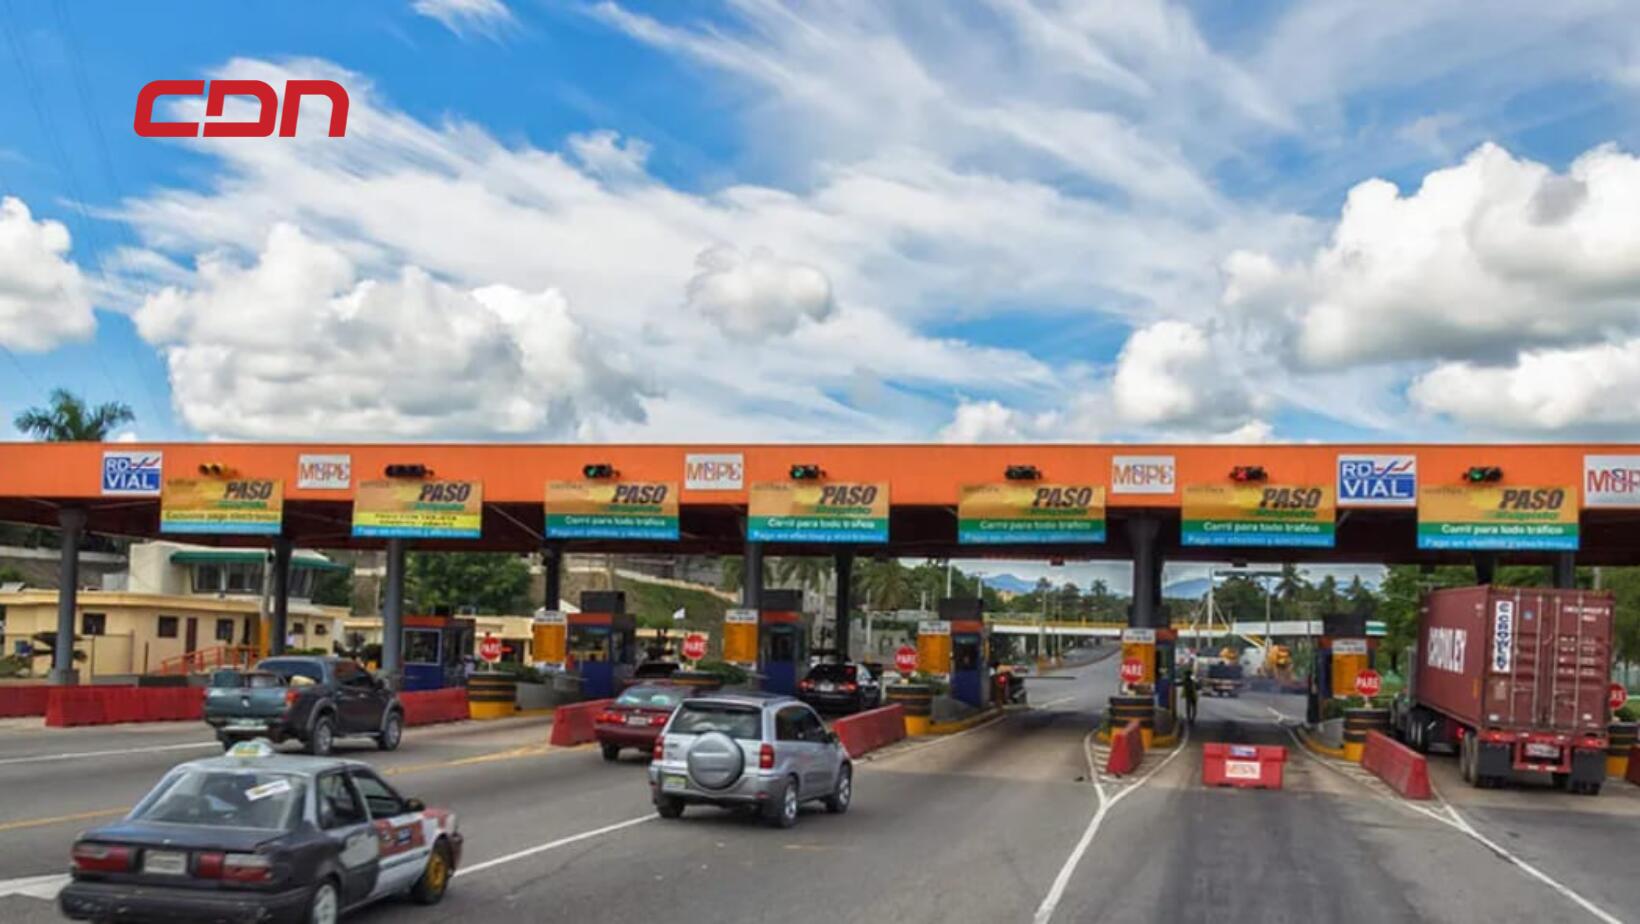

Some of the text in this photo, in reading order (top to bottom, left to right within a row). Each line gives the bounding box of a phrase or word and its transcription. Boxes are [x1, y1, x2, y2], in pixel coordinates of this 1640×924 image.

[105, 458, 129, 472] RD
[1341, 462, 1374, 477] RD
[106, 473, 154, 489] VIAL
[1343, 479, 1408, 497] VIAL
[224, 481, 273, 500] PASO
[418, 484, 471, 502] PASO
[612, 485, 667, 504] PASO
[819, 486, 877, 505] PASO
[1032, 487, 1092, 508] PASO
[1259, 488, 1322, 509] PASO
[1499, 489, 1564, 510] PASO
[796, 520, 818, 529] para
[820, 519, 841, 528] todo
[1010, 521, 1032, 532] para
[1035, 520, 1056, 530] todo
[1234, 523, 1257, 534] para
[1259, 523, 1283, 532] todo
[1441, 524, 1472, 534] Carril
[1474, 525, 1498, 536] para
[1501, 525, 1524, 534] todo
[896, 654, 917, 665] PARE
[1121, 663, 1143, 676] PARE
[1356, 676, 1378, 688] PARE
